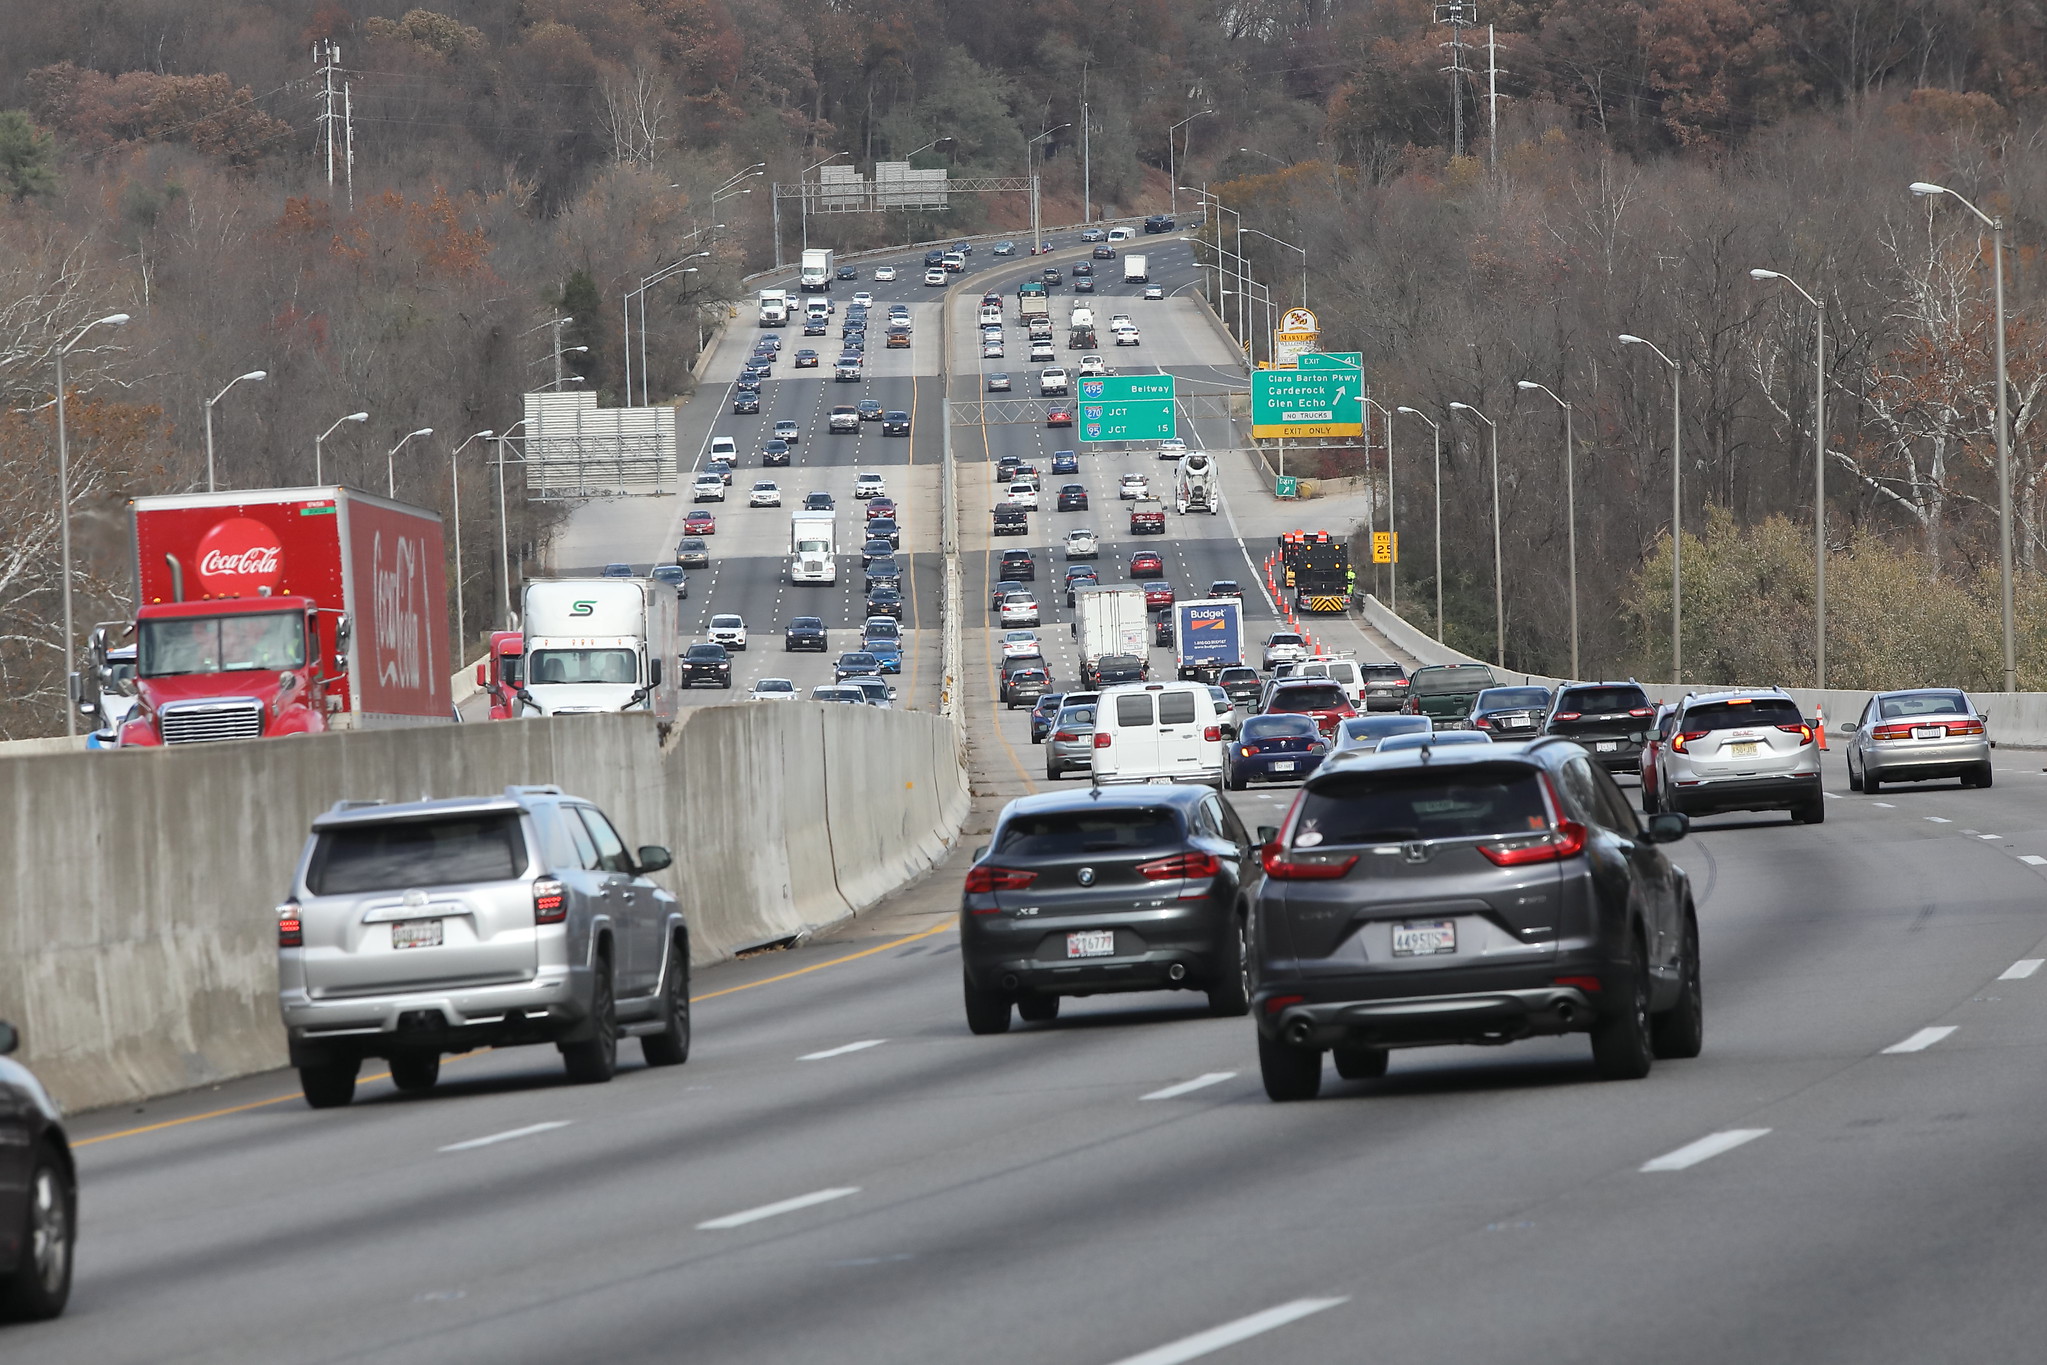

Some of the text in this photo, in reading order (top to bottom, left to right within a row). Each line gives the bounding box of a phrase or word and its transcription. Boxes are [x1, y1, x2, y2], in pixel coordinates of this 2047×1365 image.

[1344, 356, 1355, 364] 41
[1296, 374, 1328, 382] Barton
[1332, 374, 1357, 383] Pkwy
[1085, 385, 1102, 394] 495
[1131, 385, 1169, 393] Beltway
[1268, 386, 1325, 395] Carderock
[1268, 398, 1326, 408] Glen Echo
[1087, 409, 1100, 417] 270
[1108, 408, 1127, 416] JCT
[1088, 427, 1100, 436] 95
[1108, 424, 1169, 434] JCT 15
[1284, 427, 1302, 435] EXIT
[200, 547, 281, 576] Coca-Cola
[1190, 609, 1225, 620] Budget
